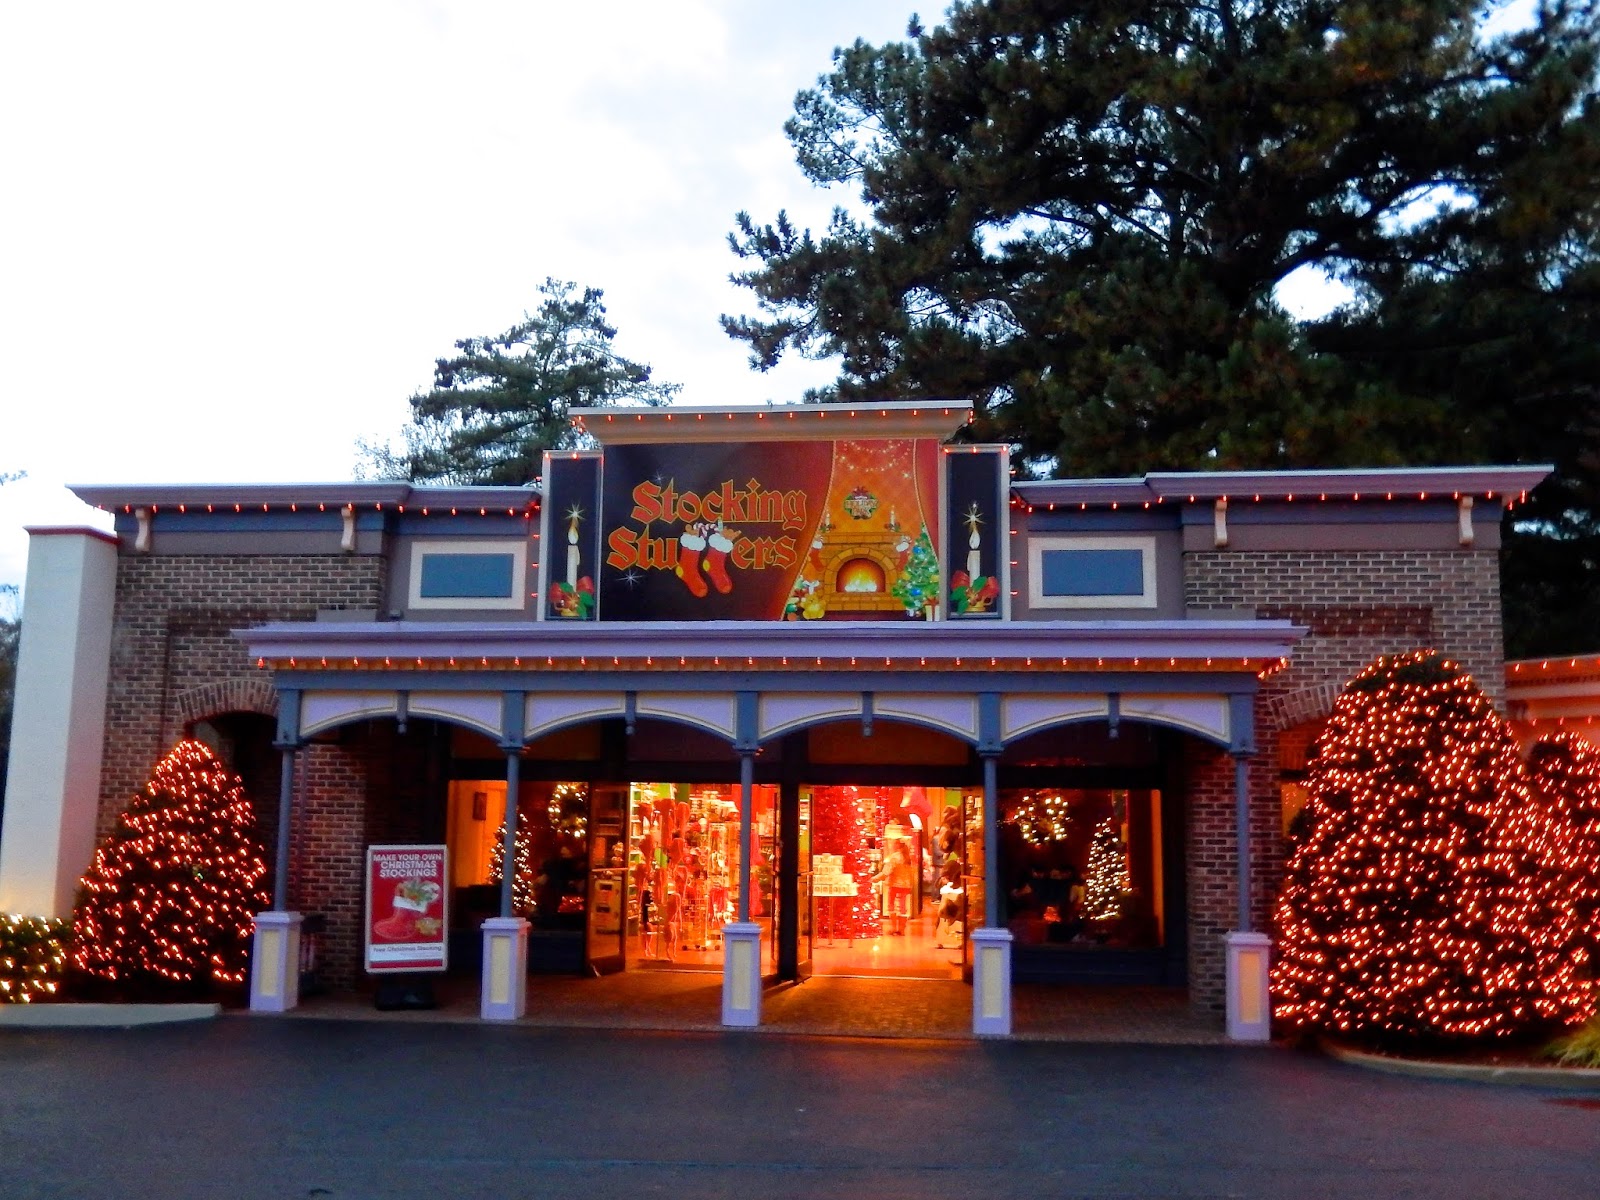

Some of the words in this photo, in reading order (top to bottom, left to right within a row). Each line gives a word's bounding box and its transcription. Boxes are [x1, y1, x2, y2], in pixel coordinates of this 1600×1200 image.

[630, 477, 808, 531] Stocking
[606, 524, 798, 571] Stuers
[373, 854, 396, 862] MAKE
[398, 853, 420, 861] YOUR
[421, 853, 442, 861] OWN
[380, 860, 437, 869] CHRISTMAS
[380, 868, 437, 878] STOCKINGS
